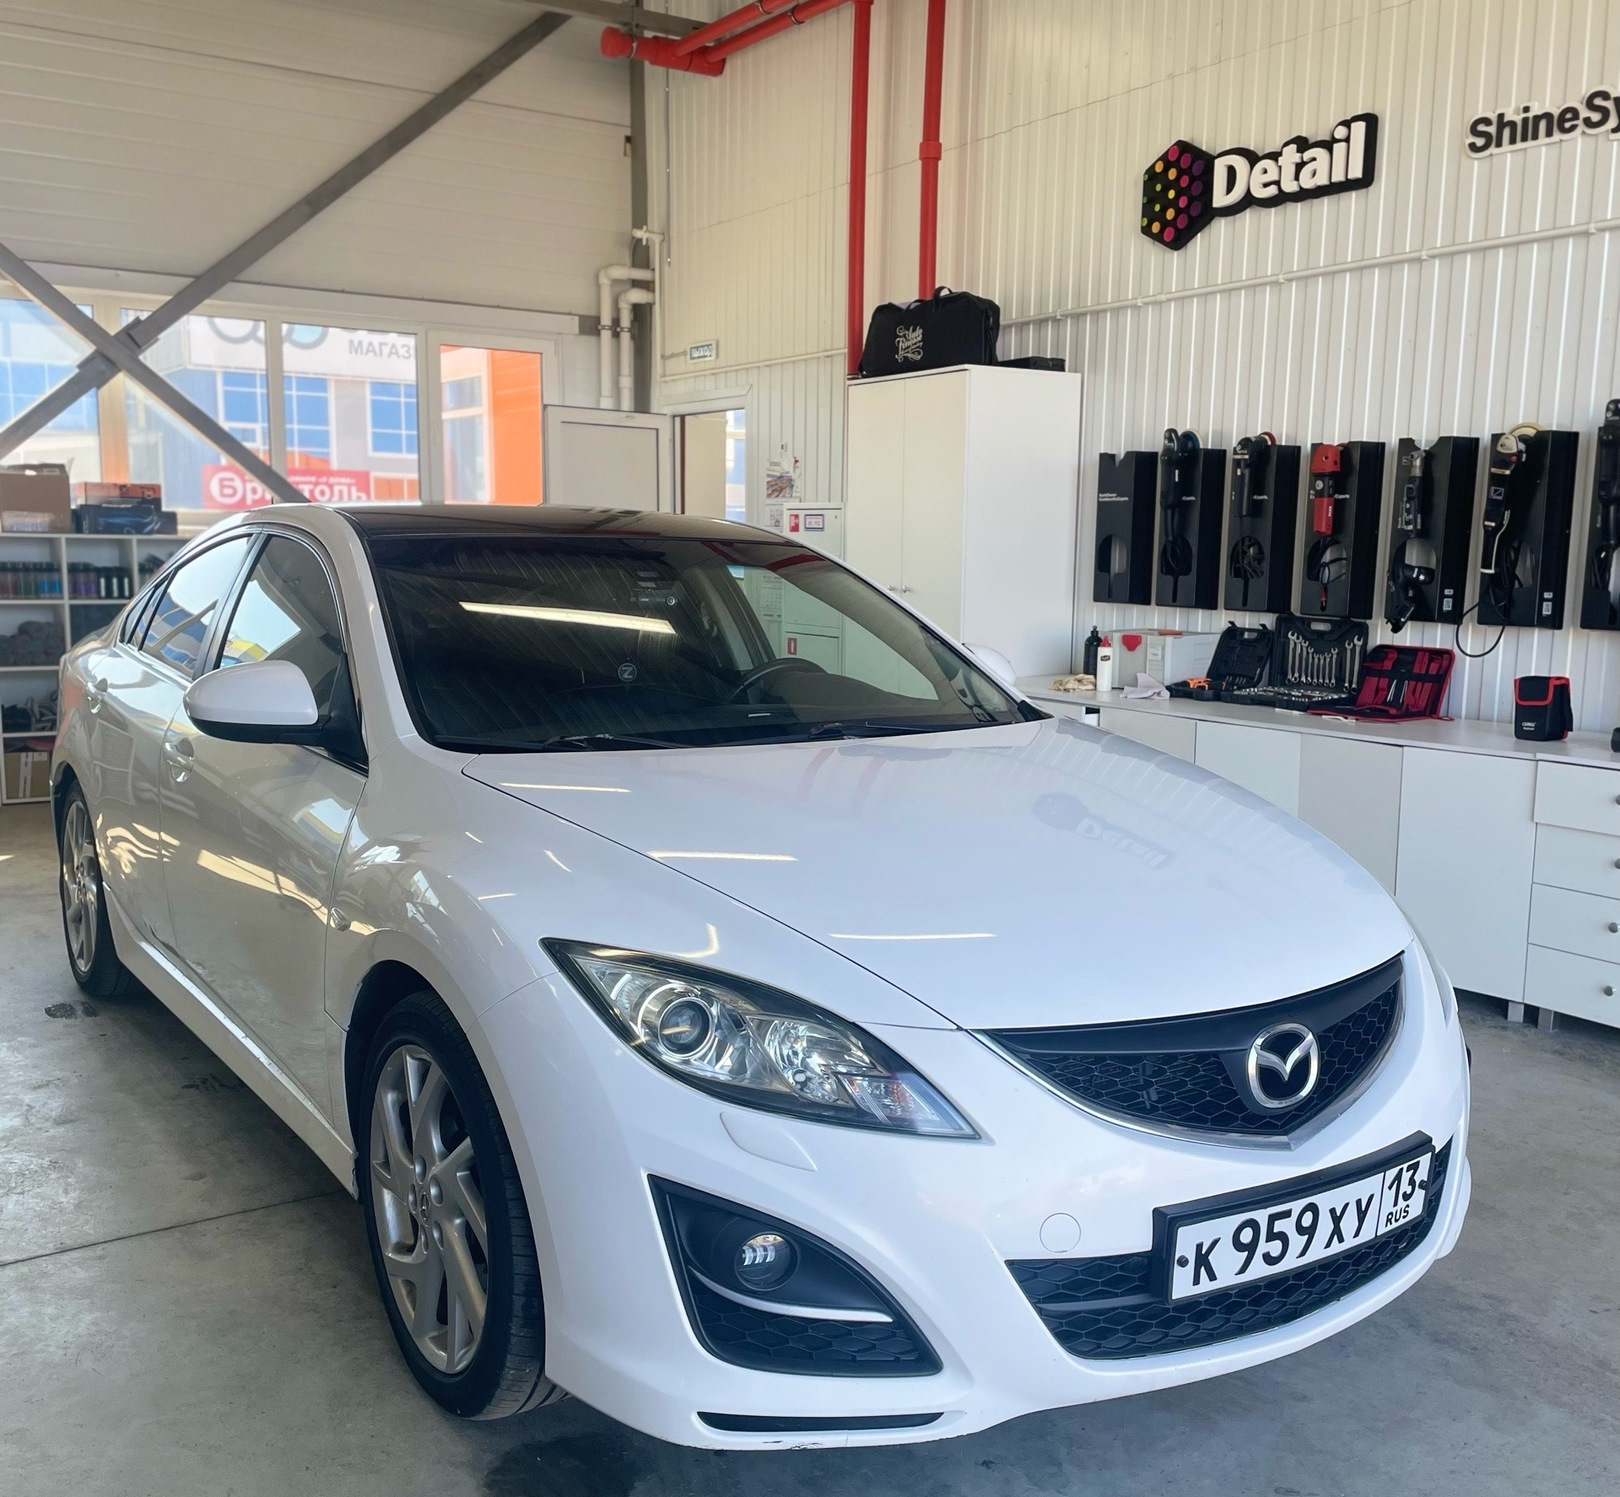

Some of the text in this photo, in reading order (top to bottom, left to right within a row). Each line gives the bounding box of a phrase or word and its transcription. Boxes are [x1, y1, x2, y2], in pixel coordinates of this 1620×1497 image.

[1212, 120, 1367, 208] Detail
[348, 339, 414, 360] МАГАЗ
[210, 472, 368, 505] Бртоль
[1387, 1159, 1421, 1208] 13
[1384, 1203, 1410, 1228] RUS
